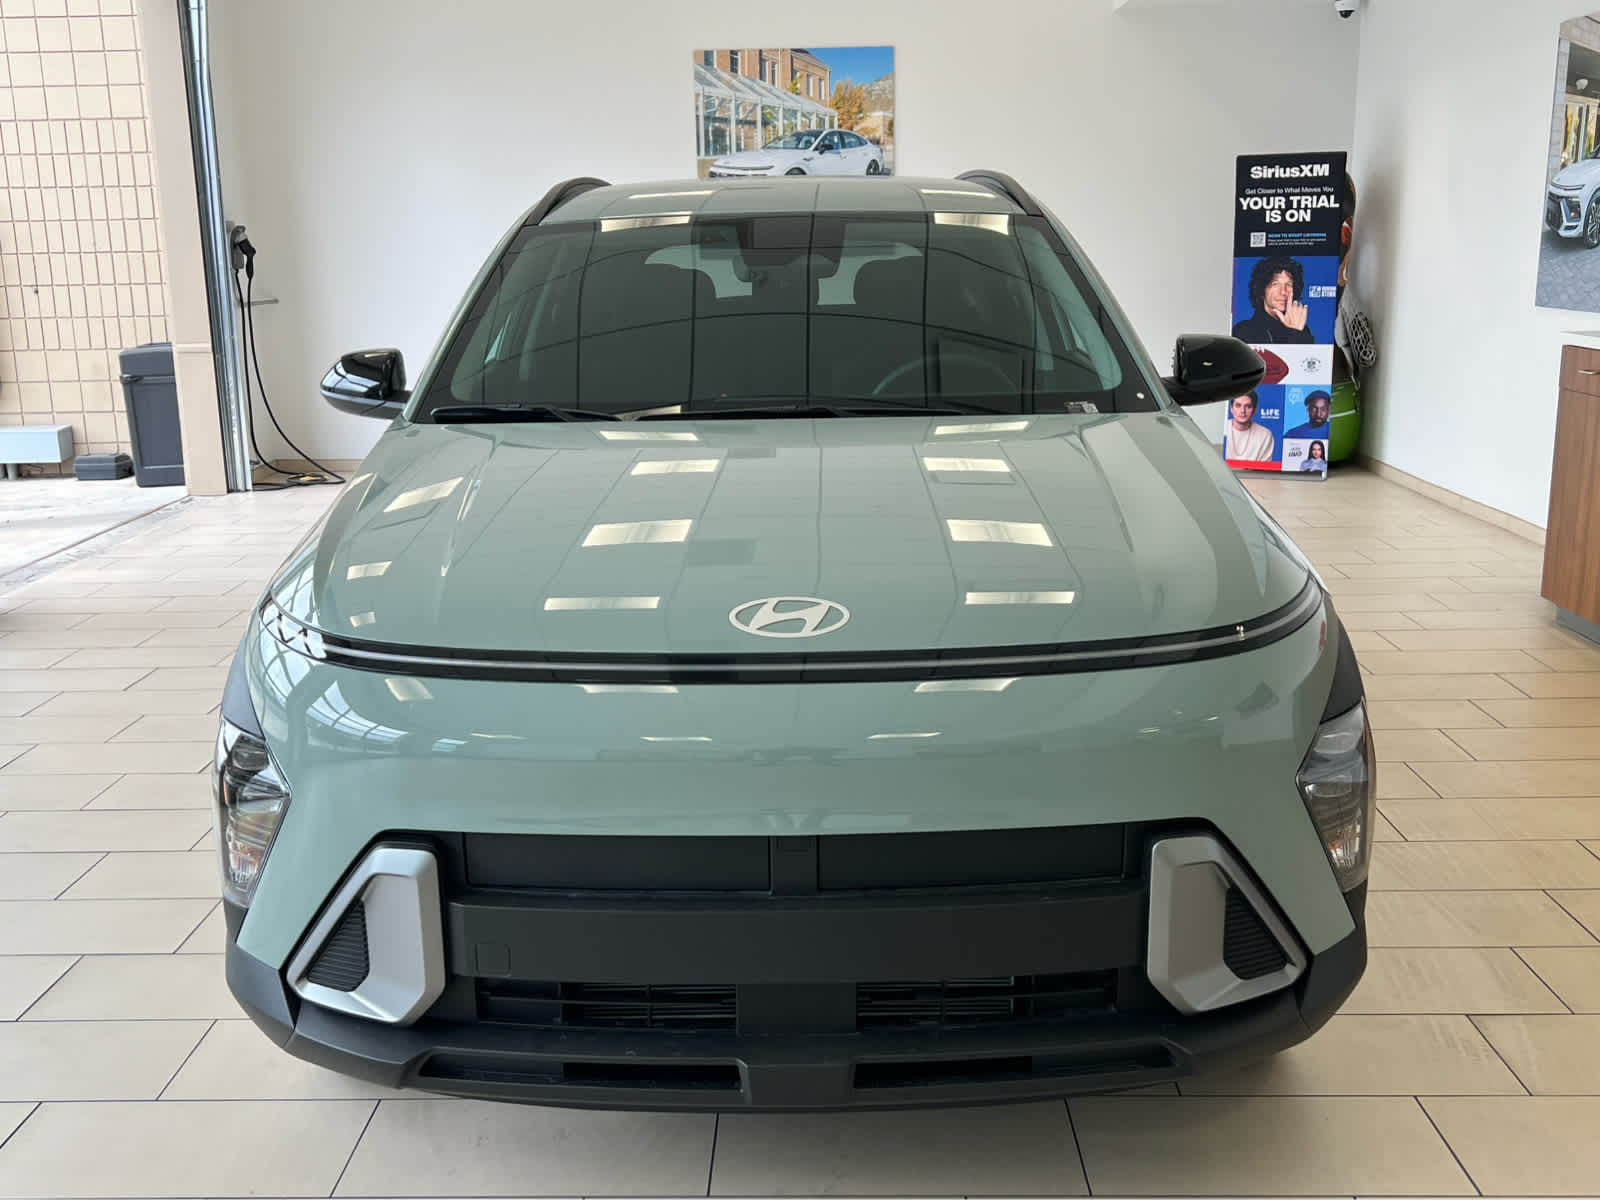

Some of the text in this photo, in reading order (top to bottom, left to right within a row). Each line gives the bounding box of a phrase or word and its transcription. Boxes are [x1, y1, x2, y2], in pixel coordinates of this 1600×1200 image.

[1250, 164, 1330, 179] SiriusXM
[1239, 195, 1340, 210] YOUR TRIAL
[1265, 209, 1311, 223] IS ON
[1260, 407, 1279, 416] LIFE
